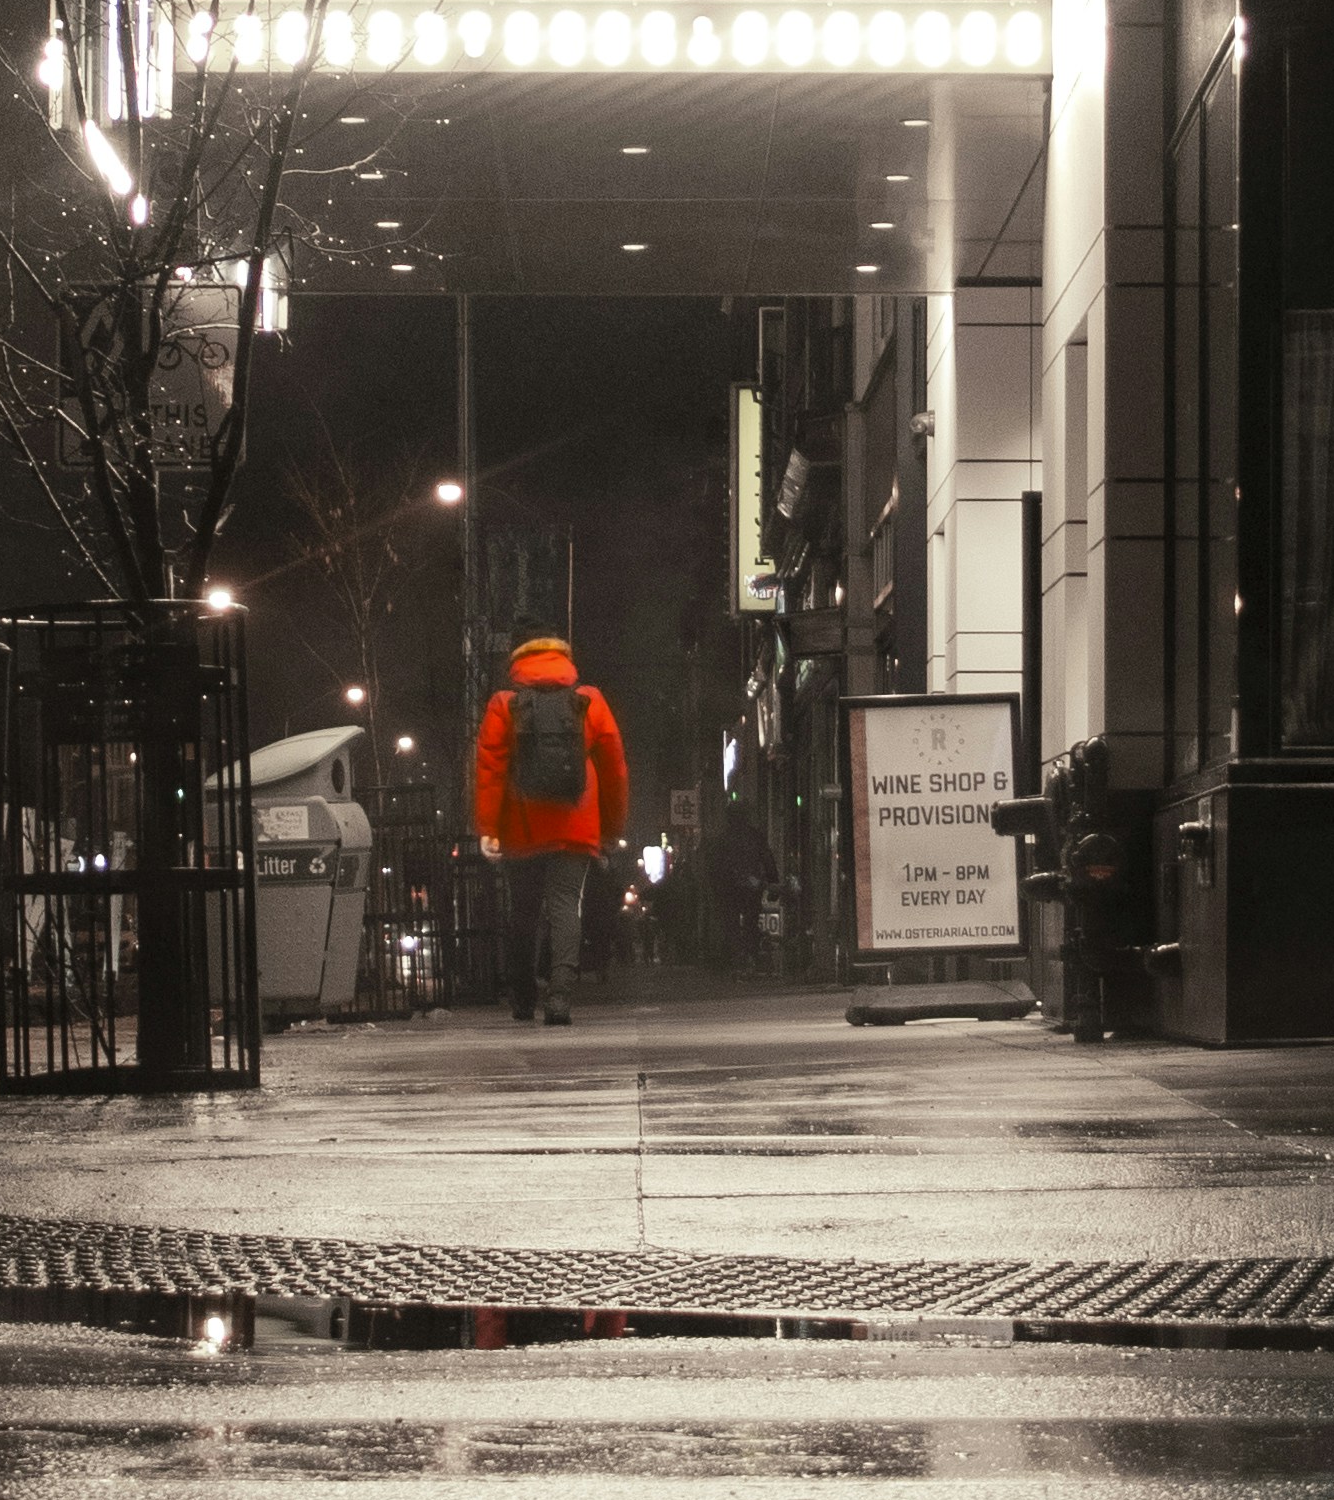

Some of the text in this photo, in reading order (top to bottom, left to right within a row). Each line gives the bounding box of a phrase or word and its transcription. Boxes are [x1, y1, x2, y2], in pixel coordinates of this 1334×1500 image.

[931, 728, 947, 750] R
[872, 771, 1008, 795] WINE SHOP &
[878, 803, 990, 827] PROVISION
[902, 862, 937, 882] 1PM
[955, 864, 990, 881] 8PM
[901, 888, 987, 907] EVERY DAY
[875, 925, 1016, 940] WWW.OSTERIARIALTO.COM
